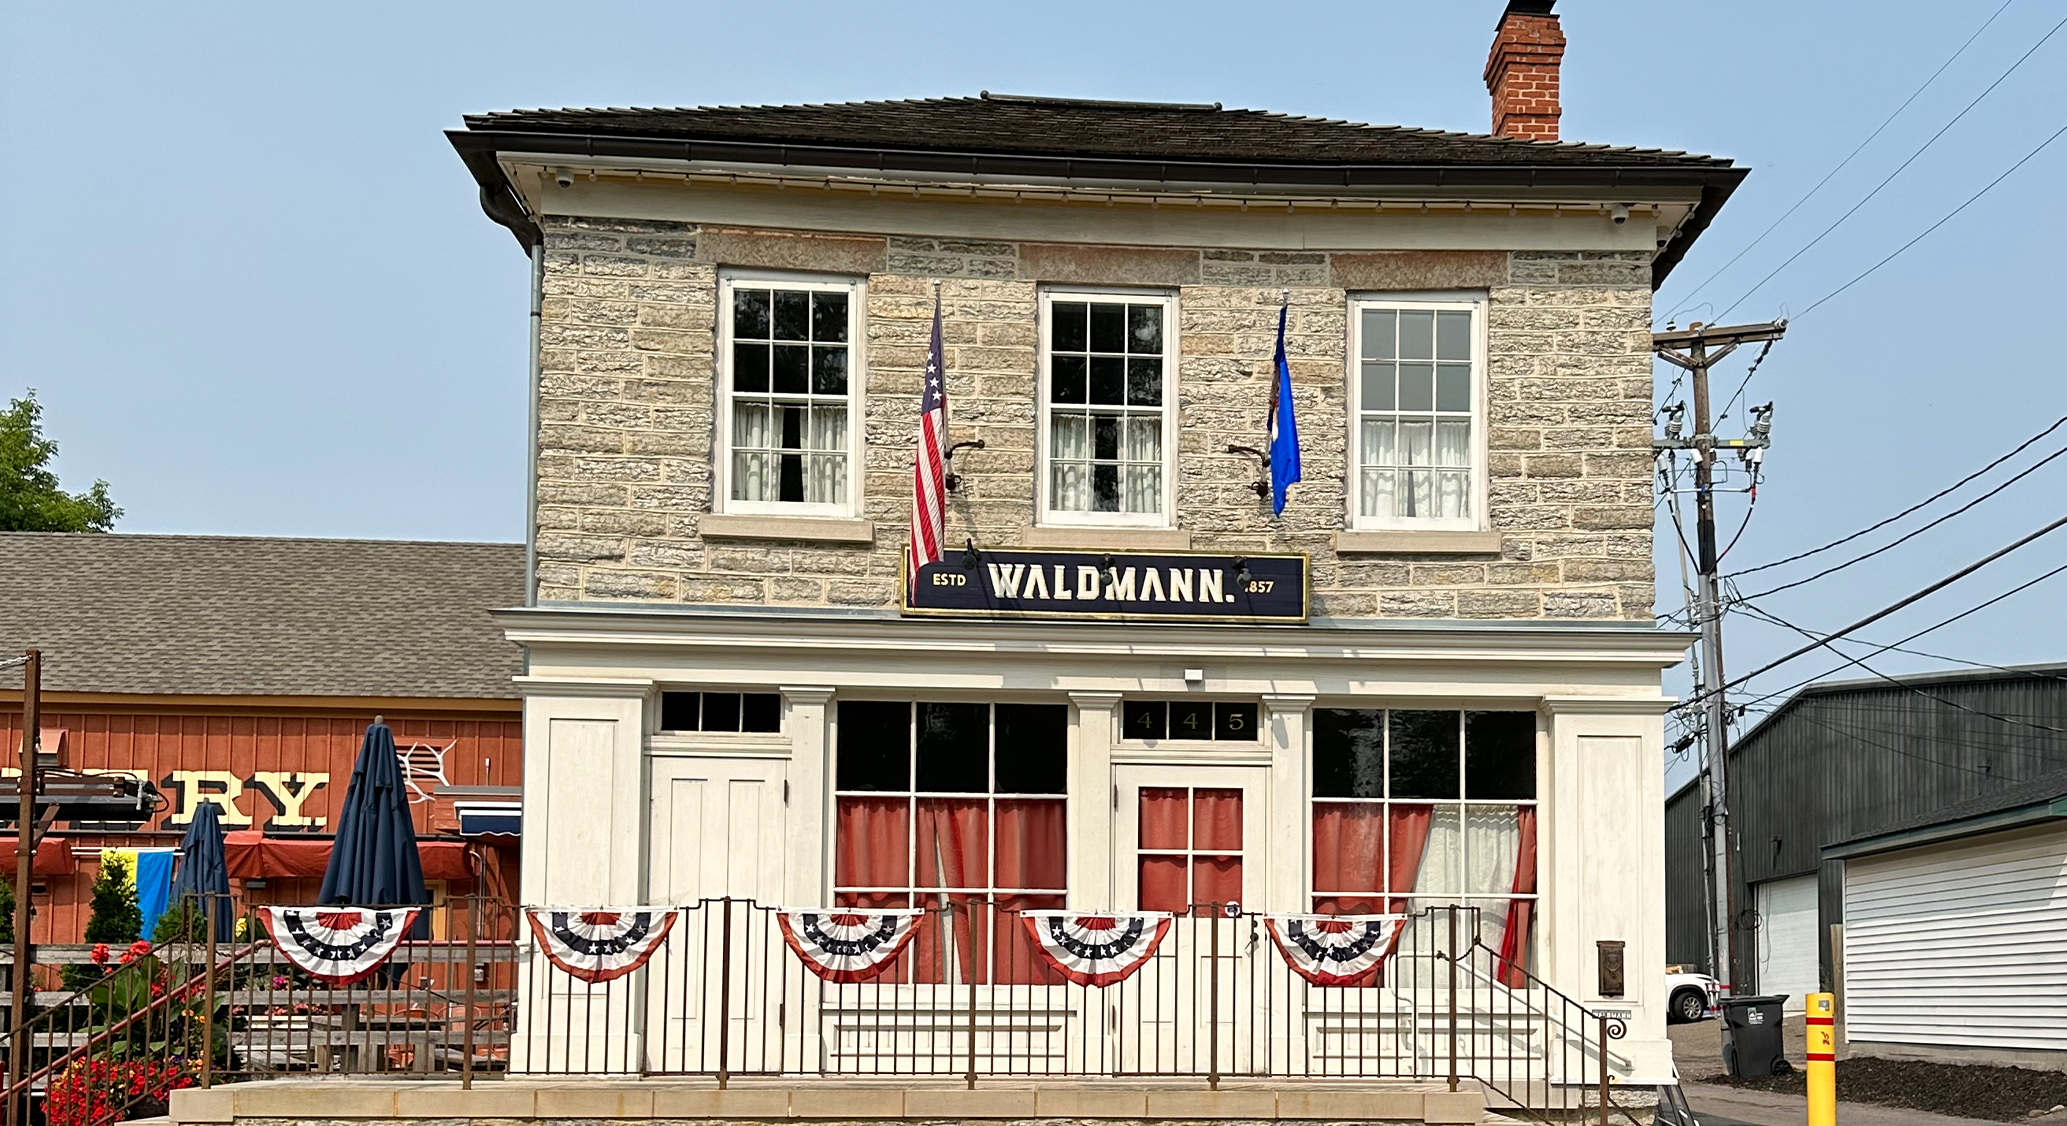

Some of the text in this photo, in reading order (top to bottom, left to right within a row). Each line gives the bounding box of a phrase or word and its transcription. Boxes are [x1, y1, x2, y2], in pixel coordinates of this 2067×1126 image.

[933, 563, 1275, 603] ESTD WALDMANN. 857
